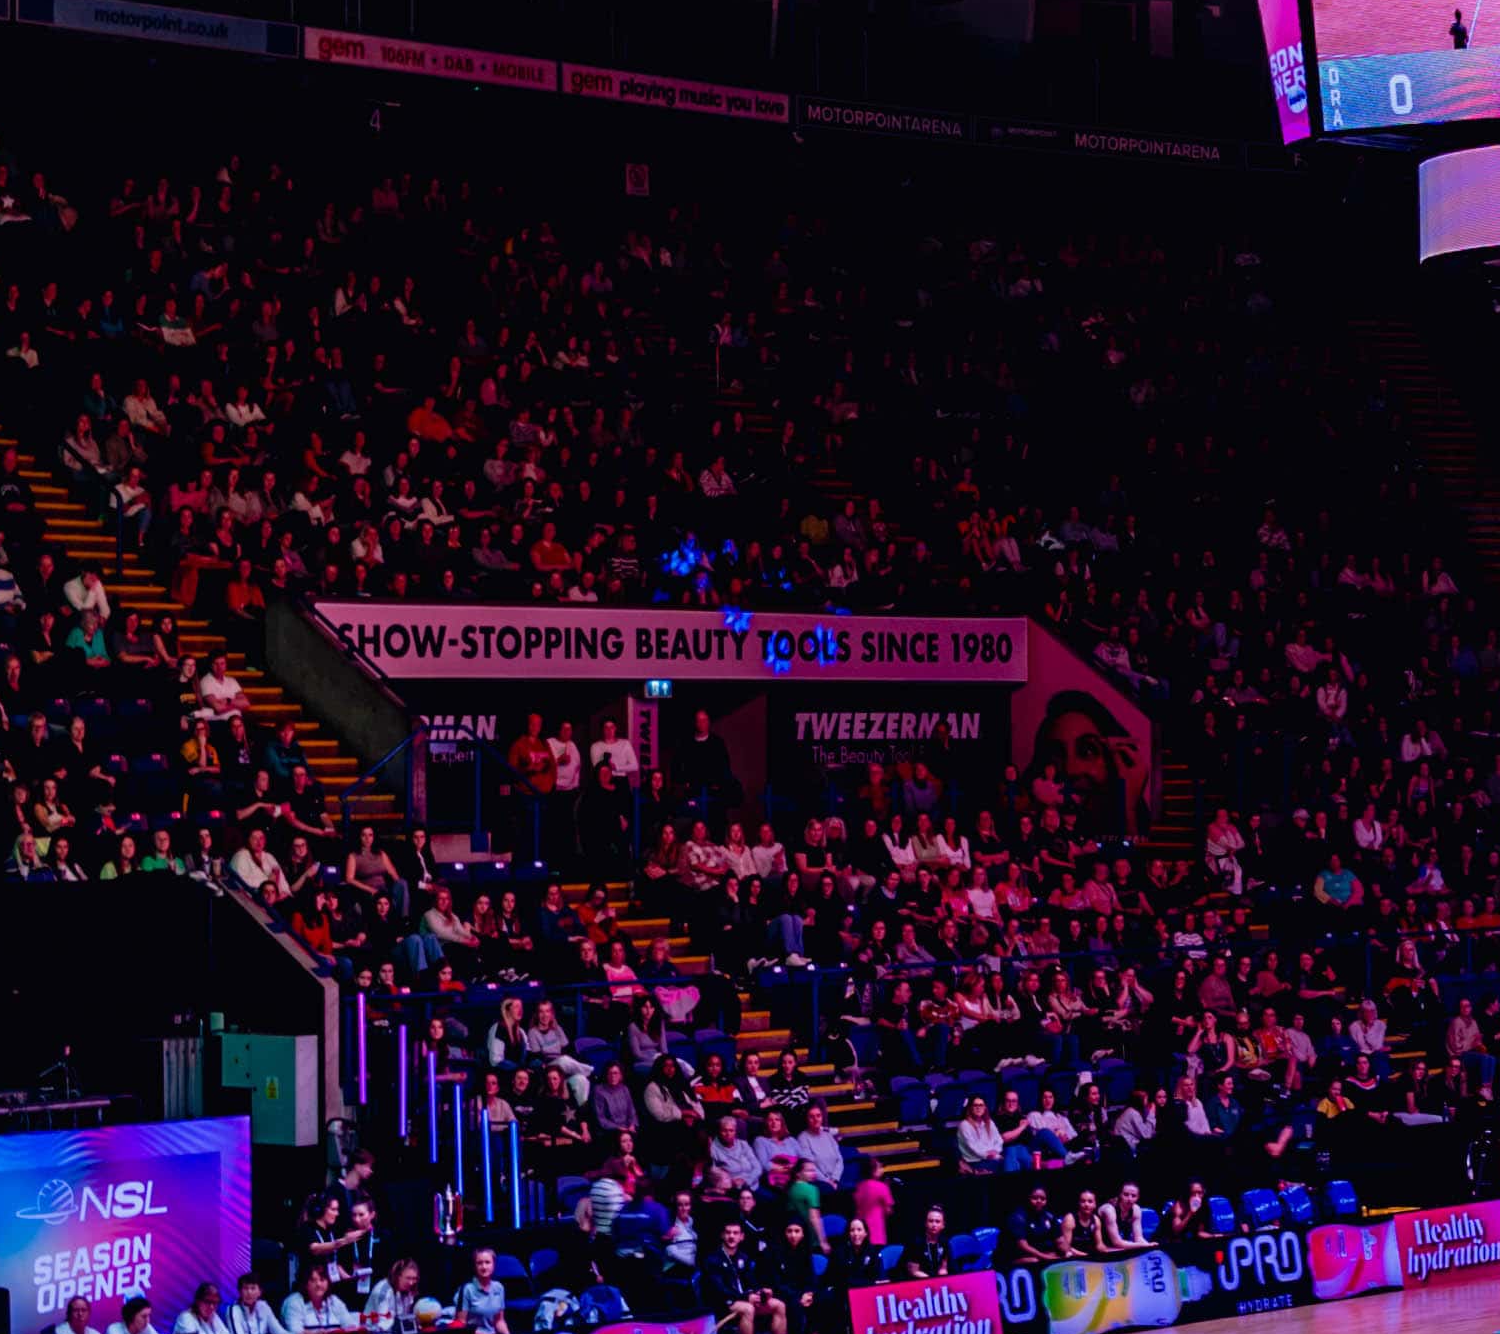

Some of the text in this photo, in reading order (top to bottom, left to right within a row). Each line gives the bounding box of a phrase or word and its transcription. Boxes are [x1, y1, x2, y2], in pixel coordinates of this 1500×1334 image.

[93, 6, 229, 40] motorpoint.co.uk
[318, 34, 367, 63] gem
[381, 45, 425, 68] 106FM
[492, 60, 546, 86] MOBILE
[571, 71, 786, 117] gem playing music you love
[1388, 73, 1413, 115] 0
[806, 104, 965, 139] MOTORPOINTARENA
[1074, 130, 1221, 161] MOTORPOINTARENA
[338, 624, 1012, 665] SHOW-STOPPING BEAUTY TOOLS SINCE 1980
[812, 745, 830, 764] The
[79, 1180, 168, 1221] NSL
[1413, 1212, 1485, 1249] Healthy
[33, 1232, 152, 1287] SEASON
[36, 1262, 152, 1314] OPENER
[874, 1284, 969, 1325] Healthy
[1236, 1294, 1293, 1316] HYDRATE
